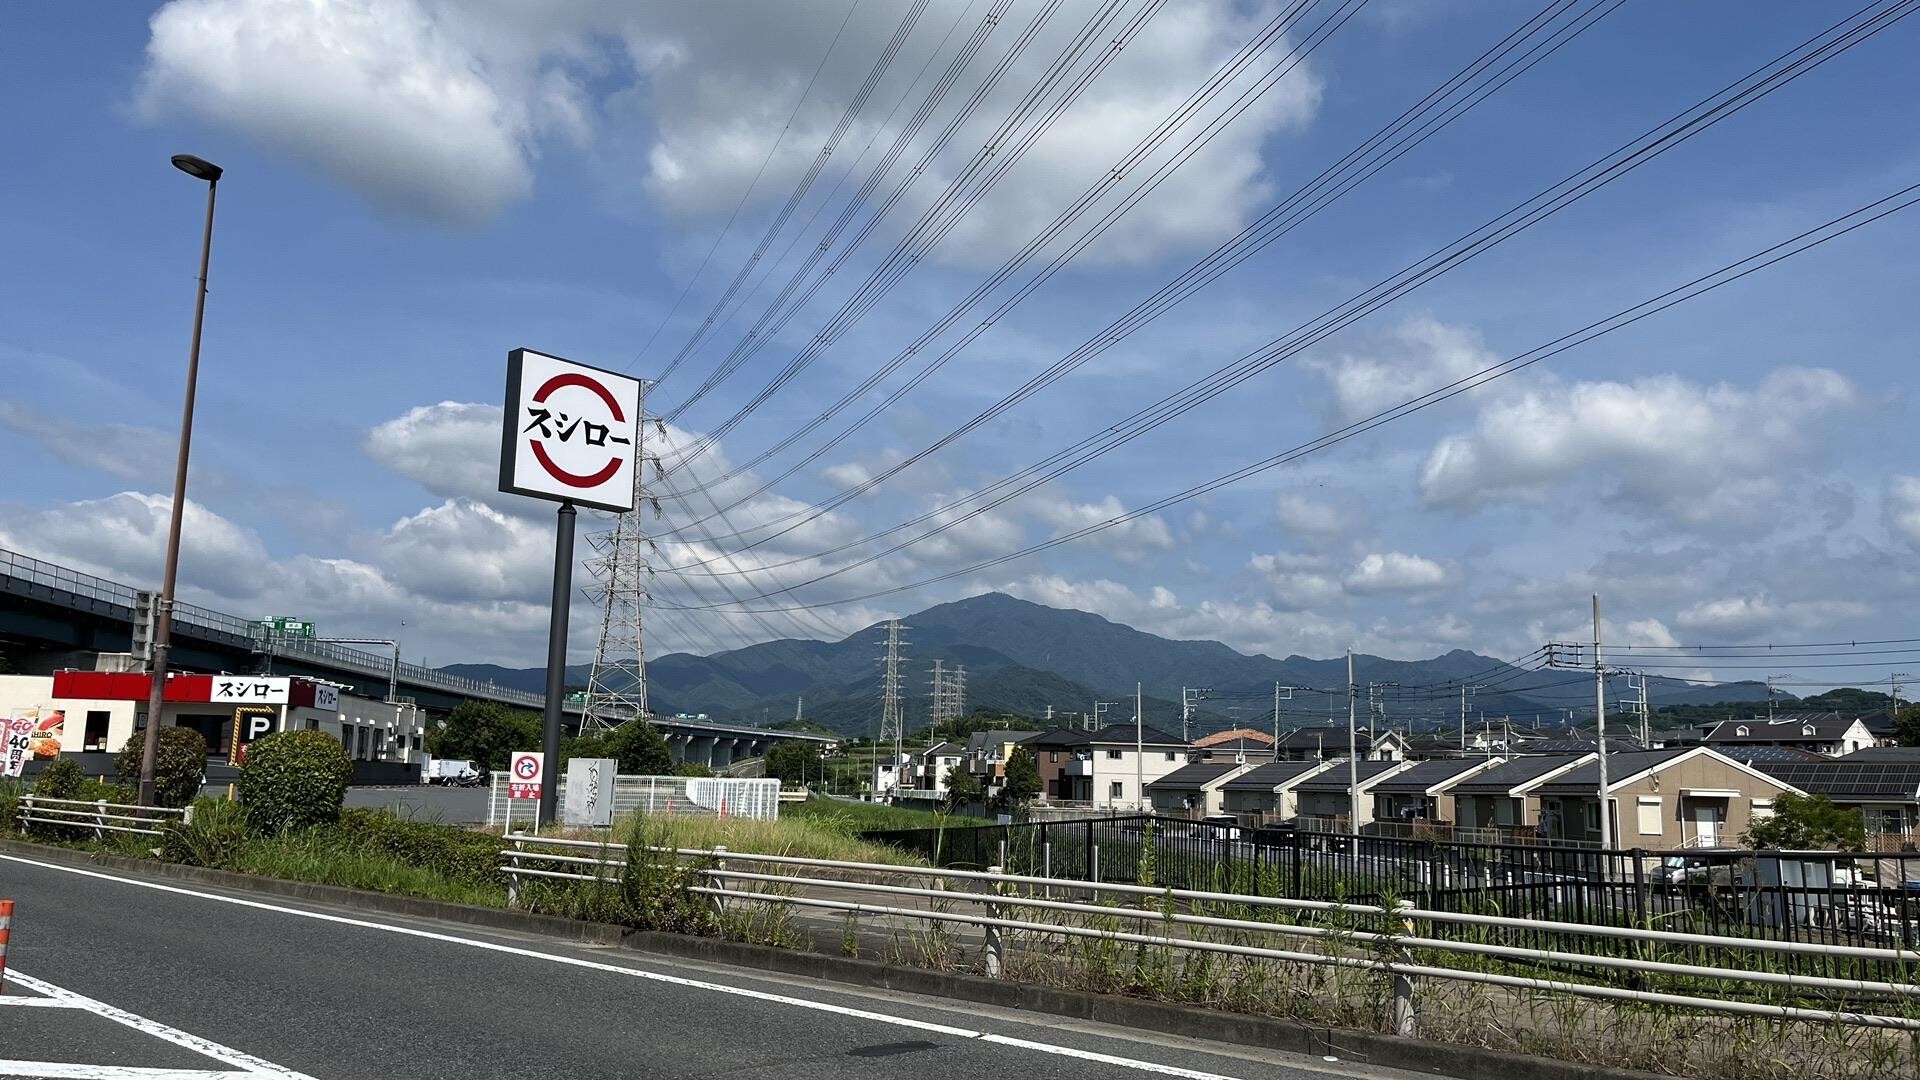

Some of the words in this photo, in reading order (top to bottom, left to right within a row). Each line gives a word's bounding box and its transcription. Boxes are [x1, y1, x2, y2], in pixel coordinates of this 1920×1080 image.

[523, 406, 631, 447] スシロー
[216, 682, 284, 697] スシロー
[318, 689, 337, 704] スシロー
[249, 717, 271, 740] P
